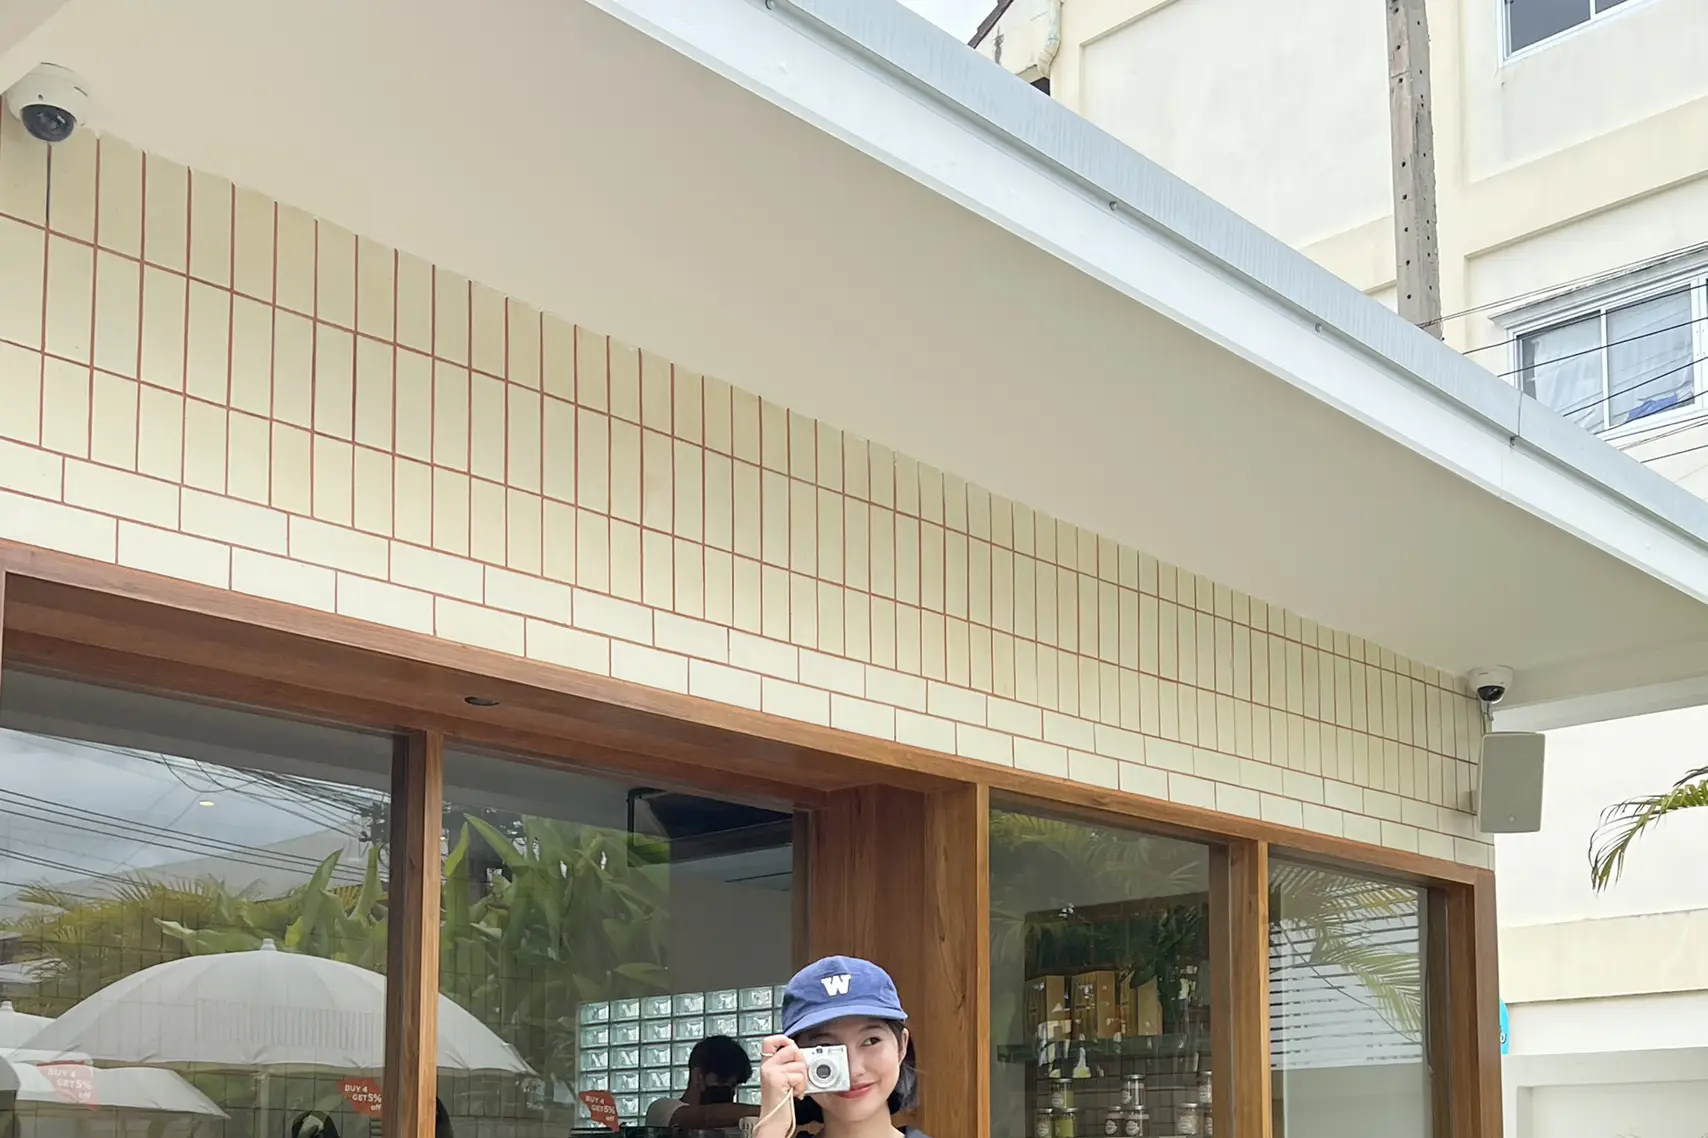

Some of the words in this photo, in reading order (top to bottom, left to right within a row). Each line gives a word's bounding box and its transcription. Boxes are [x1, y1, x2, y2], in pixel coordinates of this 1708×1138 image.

[821, 974, 851, 996] W
[344, 1084, 361, 1092] BUY
[352, 1093, 367, 1101] GET
[368, 1093, 382, 1103] 5%
[585, 1095, 599, 1103] BUY
[370, 1104, 382, 1112] off
[591, 1104, 604, 1112] GET
